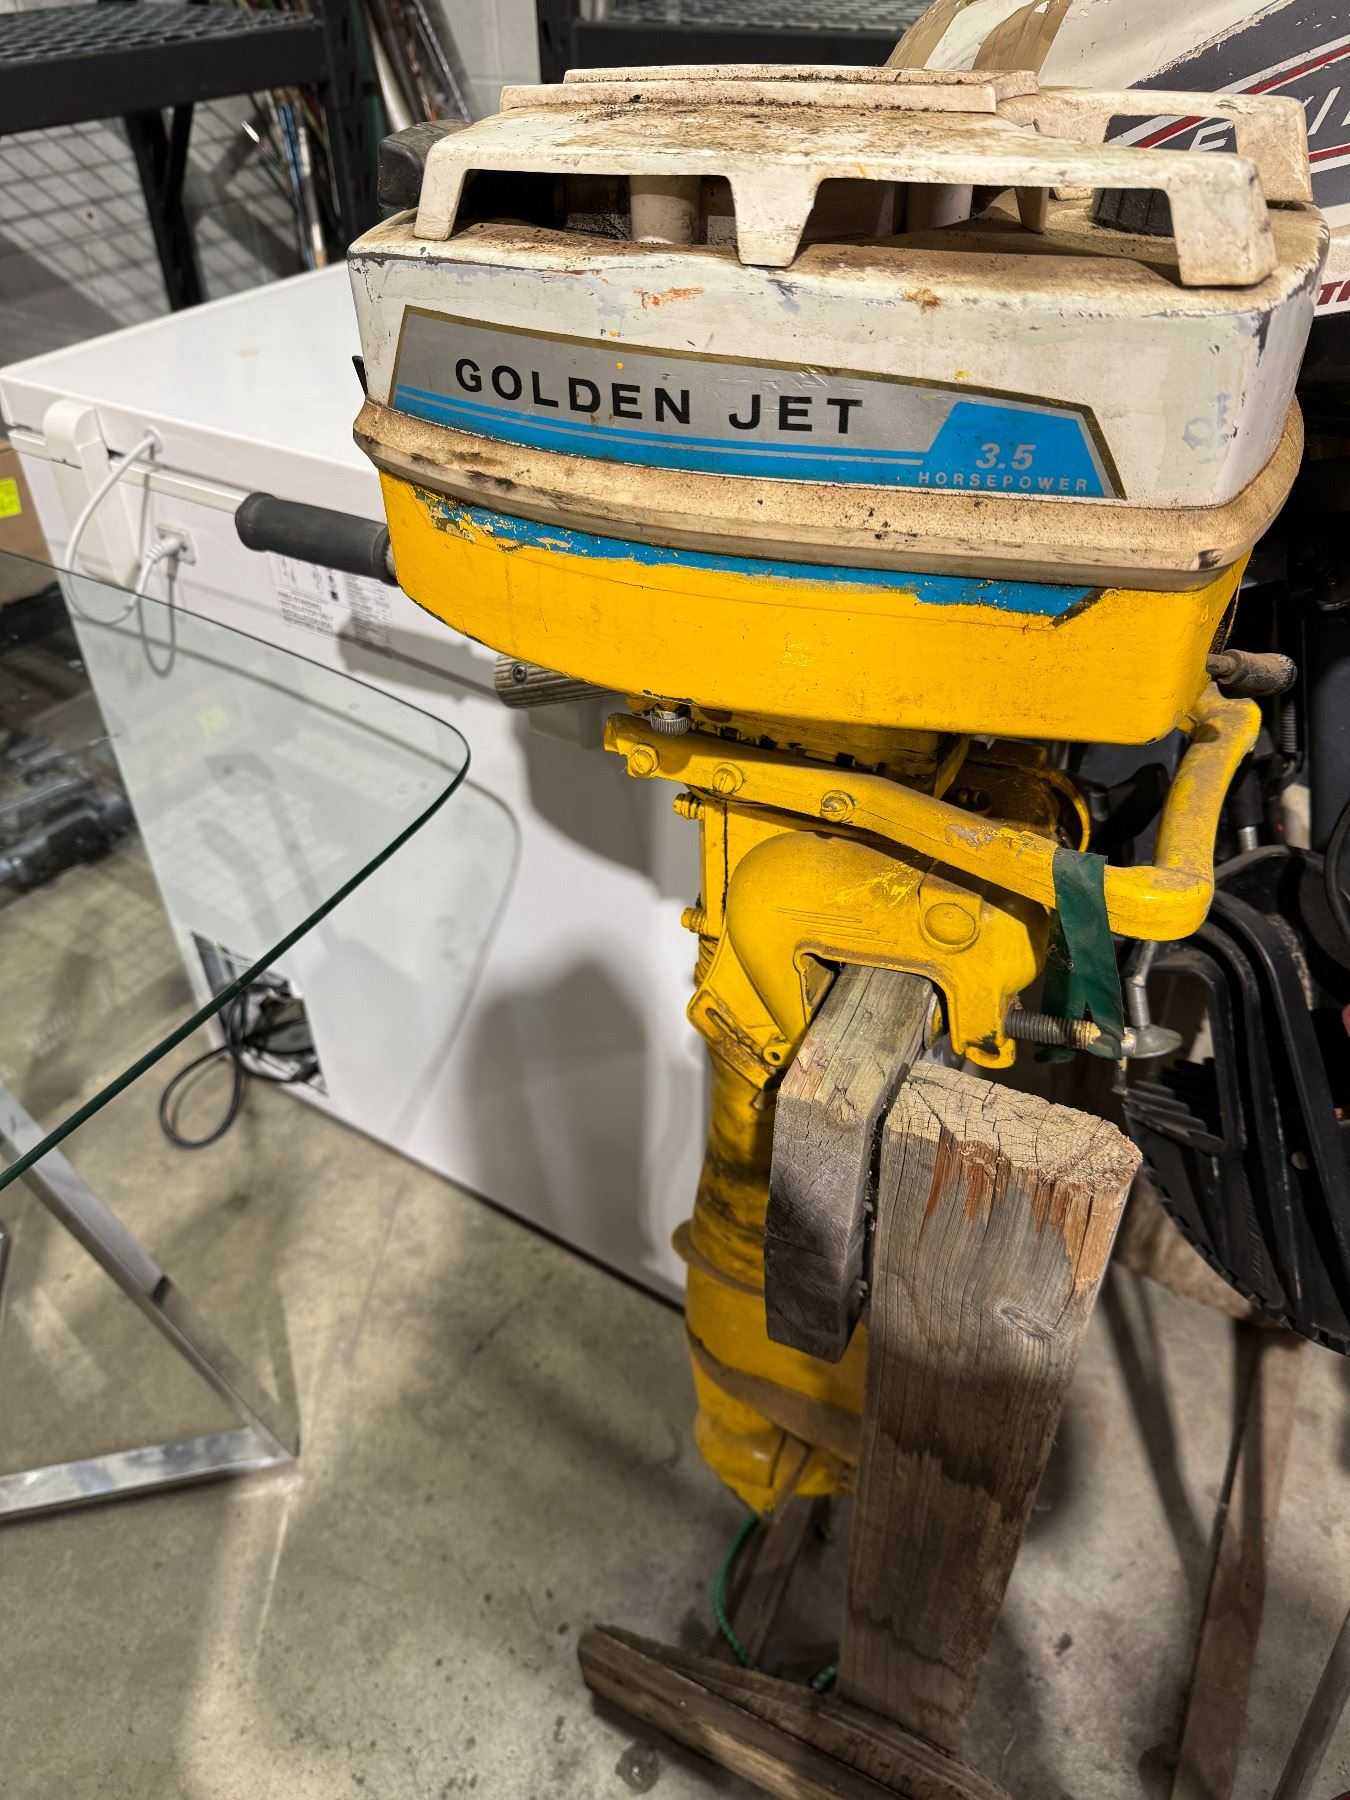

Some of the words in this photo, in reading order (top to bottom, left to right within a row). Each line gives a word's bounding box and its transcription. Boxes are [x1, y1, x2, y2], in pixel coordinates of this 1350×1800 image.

[455, 358, 690, 424] GOLDEN
[728, 393, 863, 434] JET
[975, 442, 1037, 471] 3.5
[918, 471, 1088, 492] HORSEPOWER
